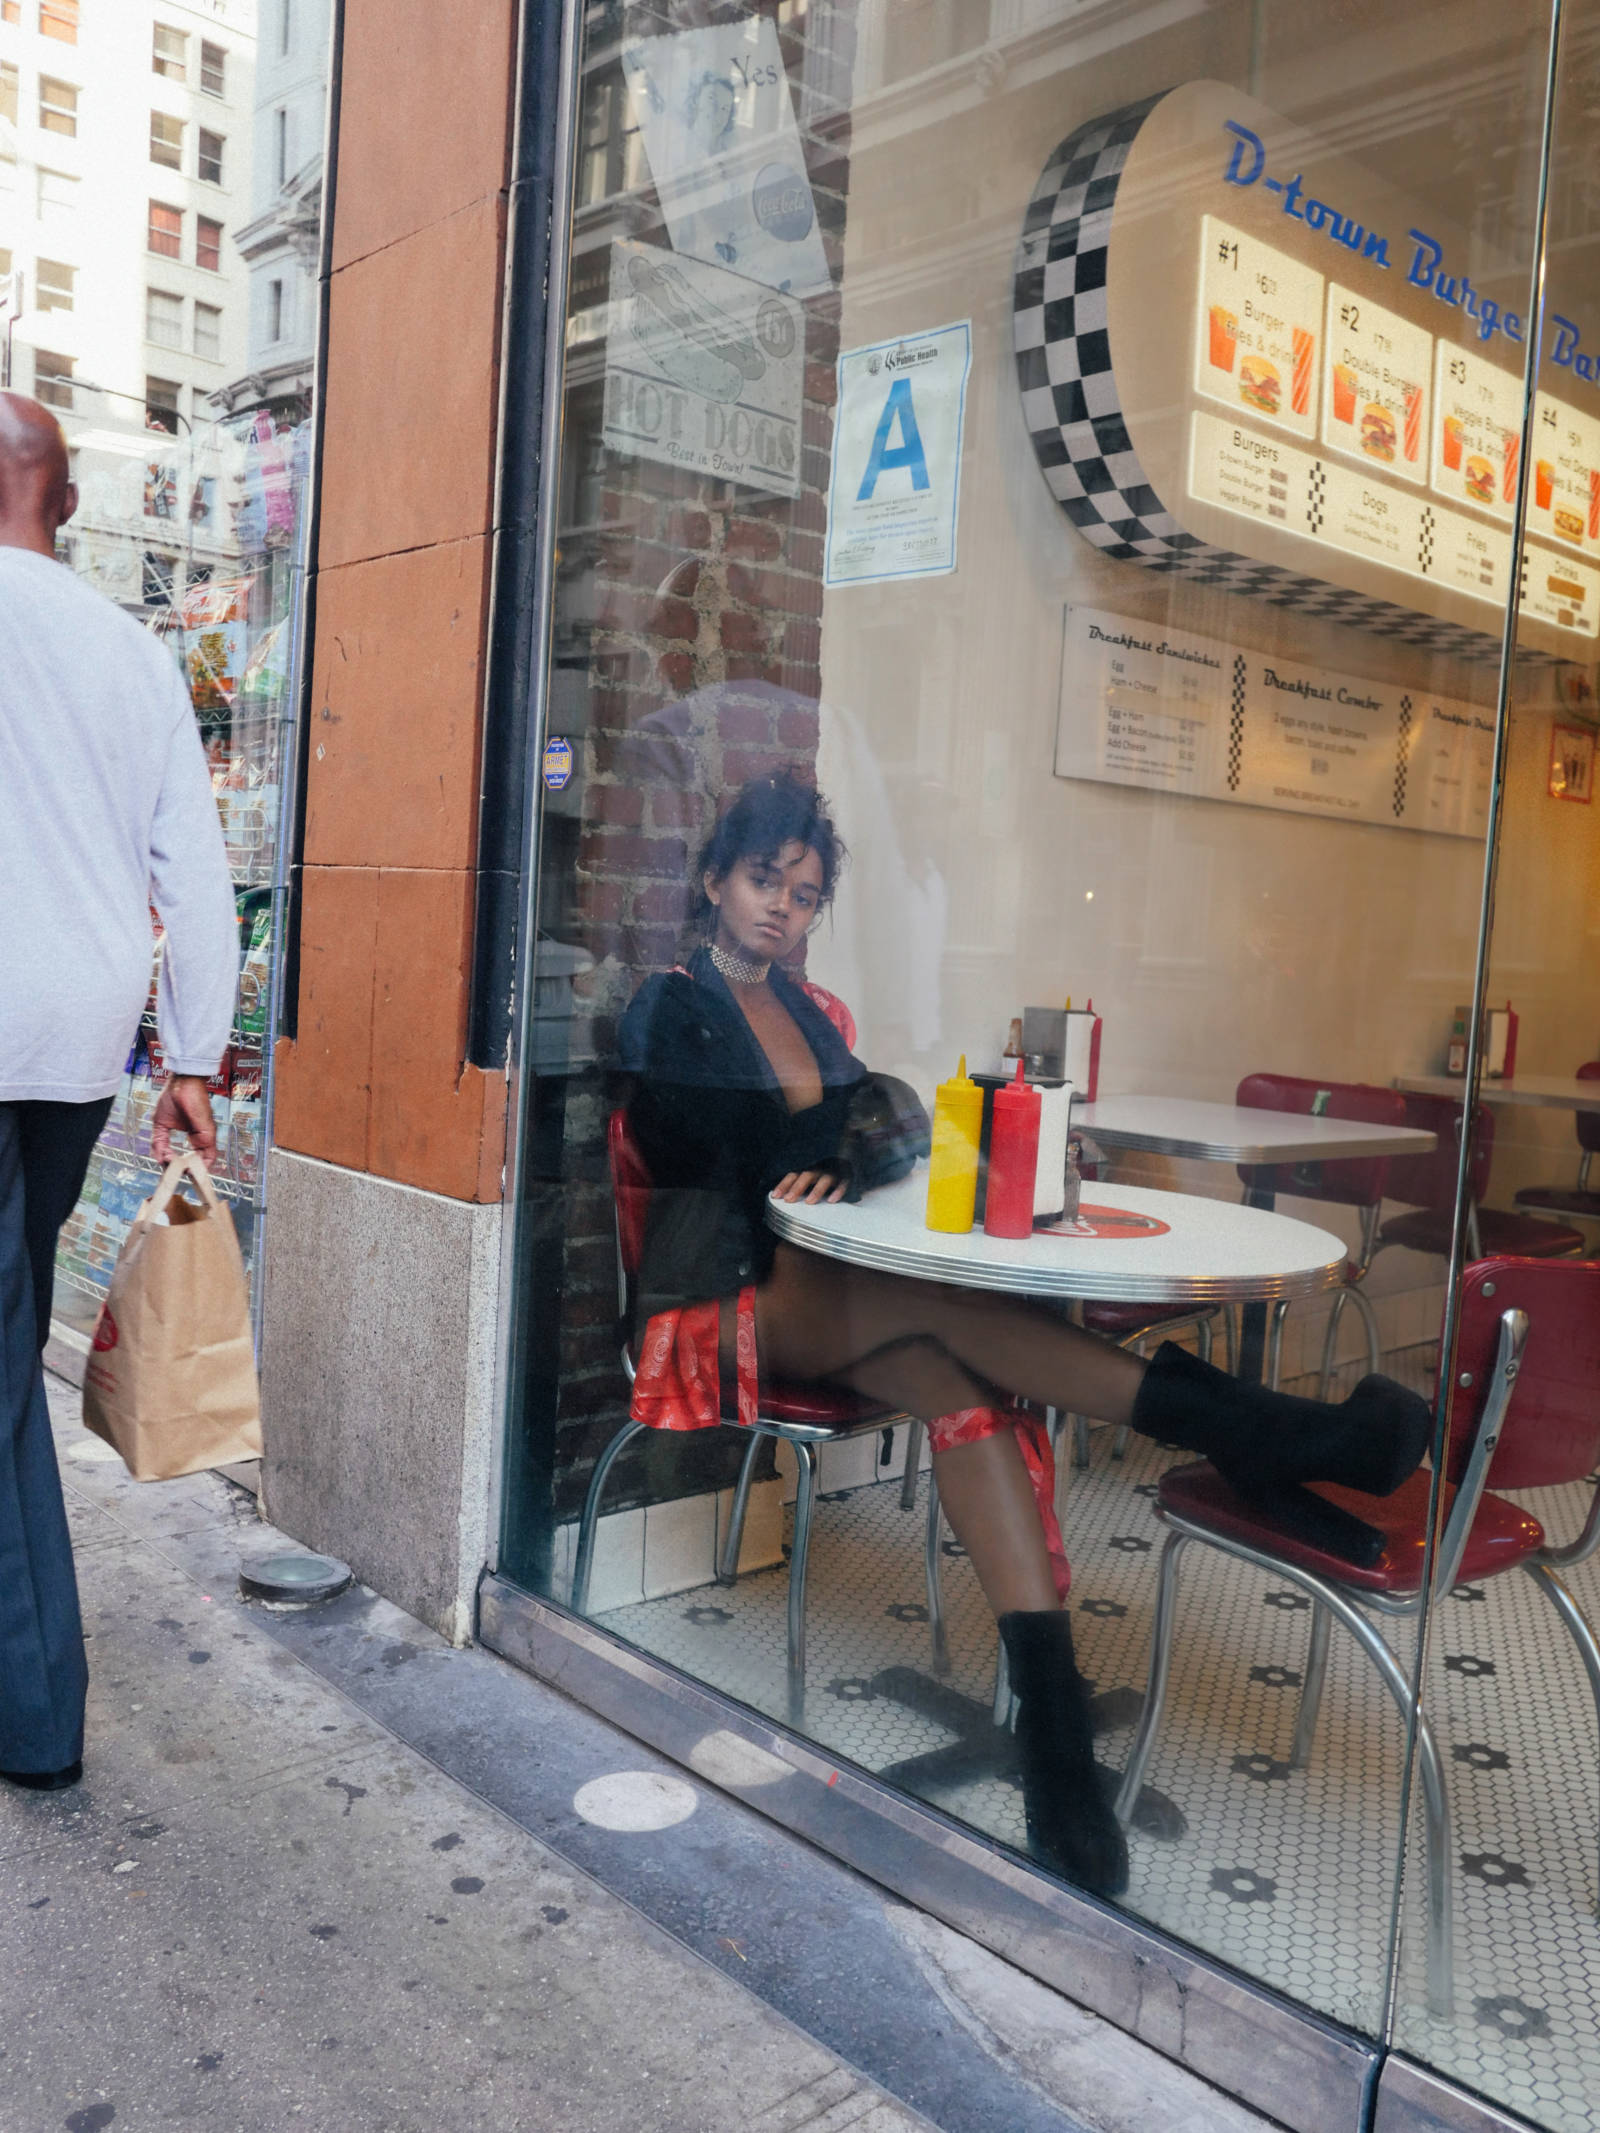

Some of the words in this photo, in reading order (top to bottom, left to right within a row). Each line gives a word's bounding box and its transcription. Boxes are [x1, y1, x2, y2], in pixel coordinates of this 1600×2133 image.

[730, 55, 778, 88] Yes
[1224, 119, 1391, 269] D-town
[1407, 228, 1526, 341] Burge
[1218, 240, 1238, 271] #1
[1245, 299, 1284, 332] Burger
[1340, 304, 1360, 332] #2
[917, 348, 938, 361] Health
[1450, 359, 1466, 384] #3
[608, 376, 689, 440] HOT
[705, 402, 797, 472] DOGS
[855, 377, 931, 502] A
[666, 442, 694, 463] Best
[1233, 430, 1279, 462] Burgers
[1363, 490, 1388, 515] Dogs
[1088, 625, 1152, 651] Breakfast
[1156, 642, 1221, 668] Sandwiches
[1264, 668, 1332, 701] Breakfast
[1336, 688, 1383, 711] Combo
